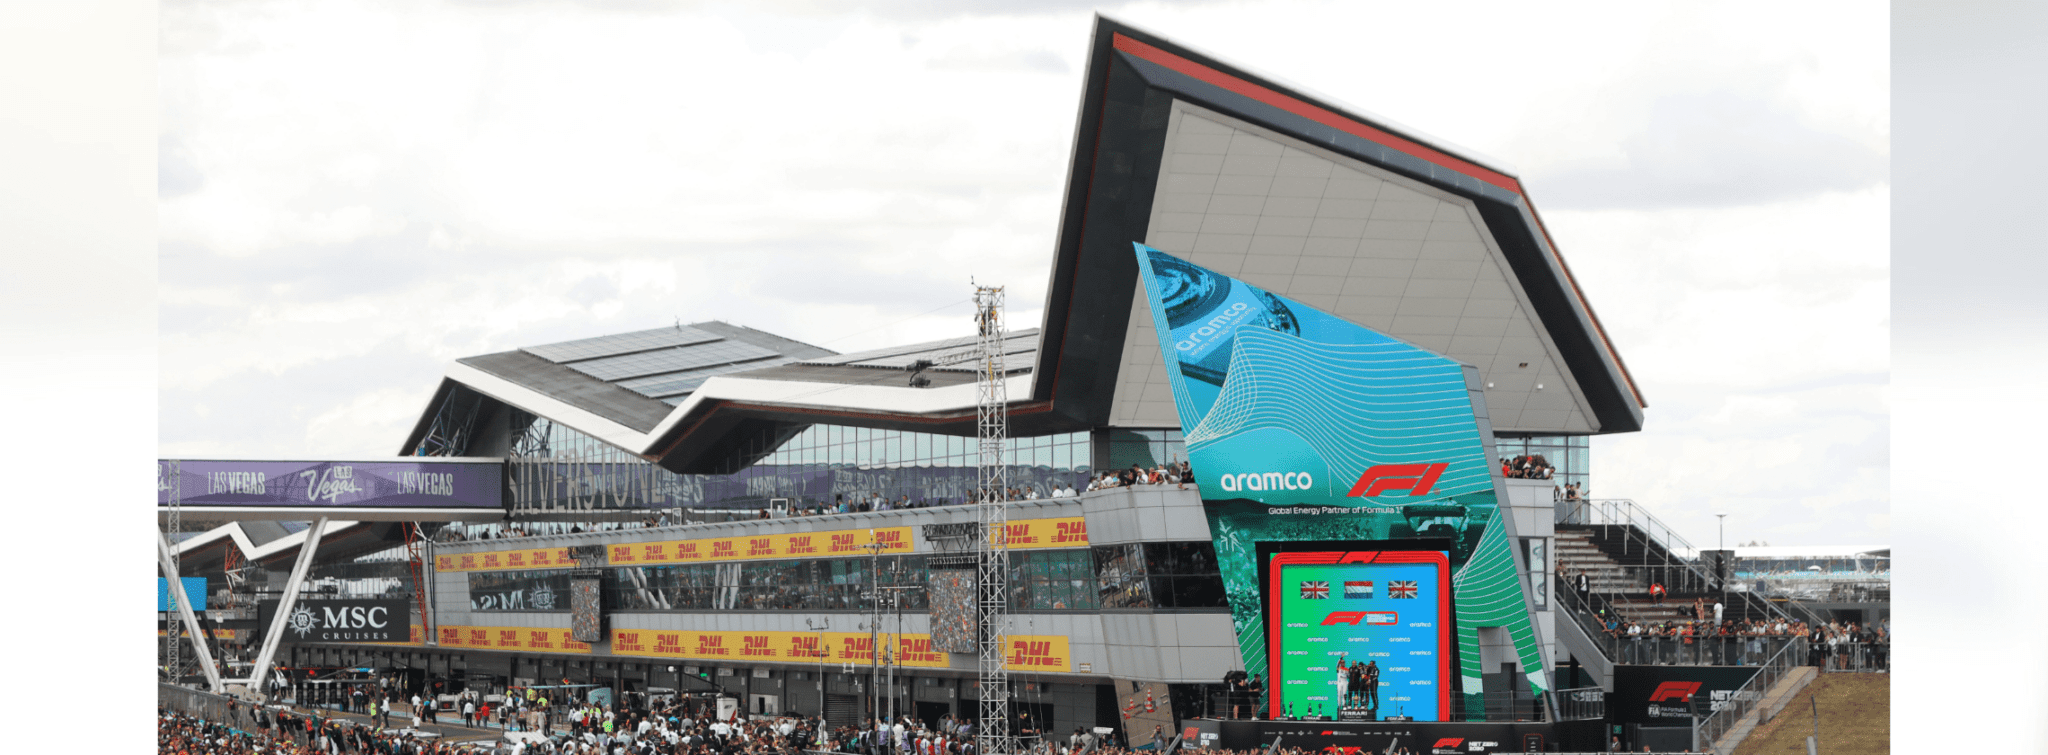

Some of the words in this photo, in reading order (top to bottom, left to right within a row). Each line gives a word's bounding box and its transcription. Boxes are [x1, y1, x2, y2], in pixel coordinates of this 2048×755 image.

[1175, 302, 1247, 351] aramco
[208, 471, 227, 494] LAS
[228, 471, 266, 495] VEGAS
[300, 468, 363, 503] Vegas
[397, 471, 416, 494] LAS
[416, 472, 454, 496] VEGAS
[508, 444, 666, 517] SILVERSTONE
[1220, 472, 1313, 492] aramco
[1346, 462, 1450, 497] F1
[1268, 507, 1292, 515] Global
[1293, 507, 1320, 515] Energy
[1322, 506, 1351, 514] Partner
[1352, 506, 1361, 514] of
[1362, 506, 1395, 514] Formula
[876, 531, 902, 549] DHL
[1056, 521, 1088, 542] DHL
[789, 536, 812, 553] DHL
[831, 534, 856, 551] DHL
[322, 606, 388, 628] MSC
[1320, 611, 1367, 625] F1
[744, 636, 770, 656] DHL
[792, 637, 820, 657] DHL
[844, 638, 876, 659] DHL
[901, 639, 935, 661] DHL
[1014, 641, 1054, 665] DHL
[1649, 681, 1703, 702] F1
[1710, 690, 1731, 701] NET
[1648, 707, 1660, 715] FIA
[1432, 738, 1465, 747] F1
